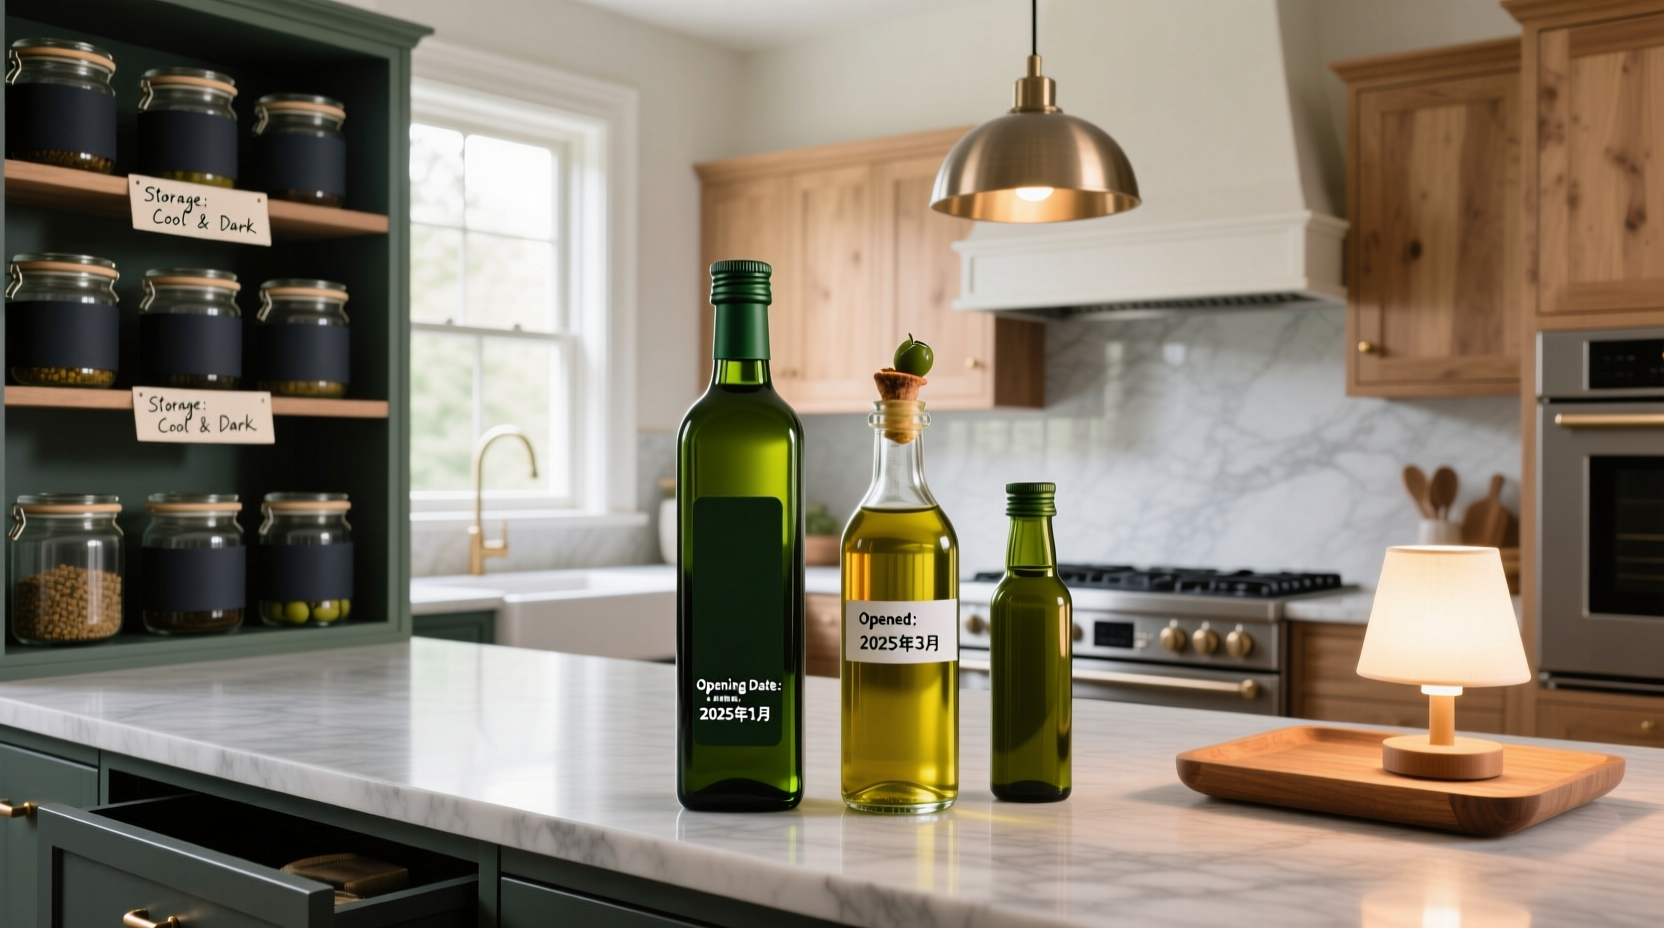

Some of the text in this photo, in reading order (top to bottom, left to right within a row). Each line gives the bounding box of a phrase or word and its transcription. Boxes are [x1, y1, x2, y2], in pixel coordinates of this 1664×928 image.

[144, 186, 207, 214] Storage:
[152, 208, 257, 234] Cool & Dark
[148, 395, 206, 421] Storage:
[157, 414, 257, 433] Cool & Dark
[858, 611, 917, 631] Opened:
[859, 634, 939, 653] 2025年3月
[749, 679, 782, 692] Date:
[699, 705, 770, 723] 2025年1月
